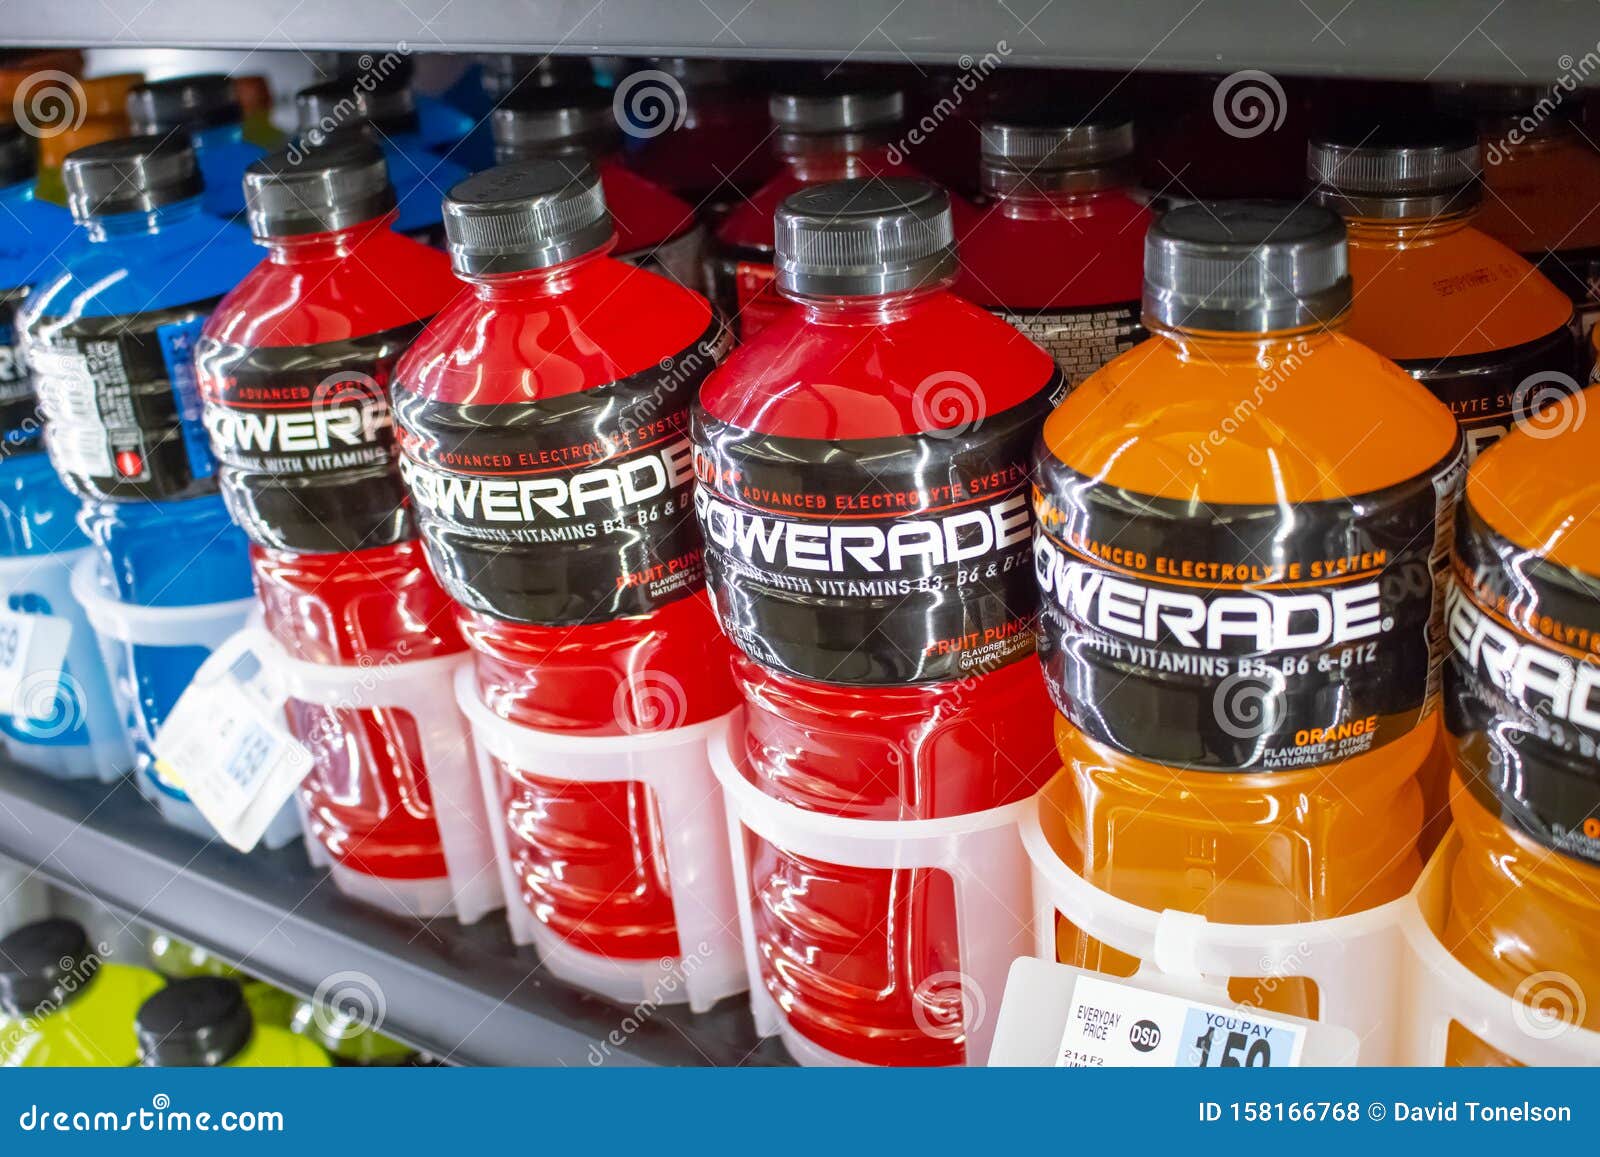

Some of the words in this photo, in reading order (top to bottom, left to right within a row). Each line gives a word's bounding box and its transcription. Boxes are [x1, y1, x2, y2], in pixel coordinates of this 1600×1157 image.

[239, 386, 310, 400] ADVANCED
[439, 452, 511, 467] ADVANCED
[743, 486, 827, 509] ADVANCED
[835, 485, 962, 510] ELECTROLYTE
[969, 464, 1028, 494] SYSTEM
[513, 522, 597, 544] VITAMINS
[637, 508, 659, 527] B6
[665, 501, 675, 516] &
[694, 482, 1032, 572] POWERADE
[615, 564, 664, 591] FRUIT
[668, 550, 702, 575] PUN
[1310, 550, 1387, 578] SYSTEM
[649, 569, 690, 590] FLAVORED
[650, 579, 686, 598] NATURAL
[770, 572, 812, 594] WITH
[820, 578, 911, 597] VITAMINS
[957, 564, 979, 586] B6
[986, 561, 998, 578] &
[925, 632, 980, 657] FRUIT
[961, 640, 1005, 659] FLAVORED
[961, 651, 1001, 669] NATURAL
[1128, 640, 1230, 678] VITAMINS
[1282, 656, 1310, 677] B6
[1317, 653, 1332, 672] &
[1340, 641, 1378, 669] B12
[1294, 714, 1378, 746] ORANGE
[1263, 742, 1327, 759] FLAVORED
[1339, 731, 1374, 749] OTHER
[1263, 756, 1318, 768] NATURAL
[1321, 741, 1371, 761] FLAVORS
[1077, 1004, 1121, 1028] EVERYDAY
[1205, 1012, 1238, 1030] YOU
[1241, 1021, 1273, 1039] PAY
[1083, 1022, 1109, 1041] PRICE
[1130, 1024, 1160, 1047] DSD
[1064, 1049, 1088, 1062] 214
[1090, 1055, 1104, 1067] F2
